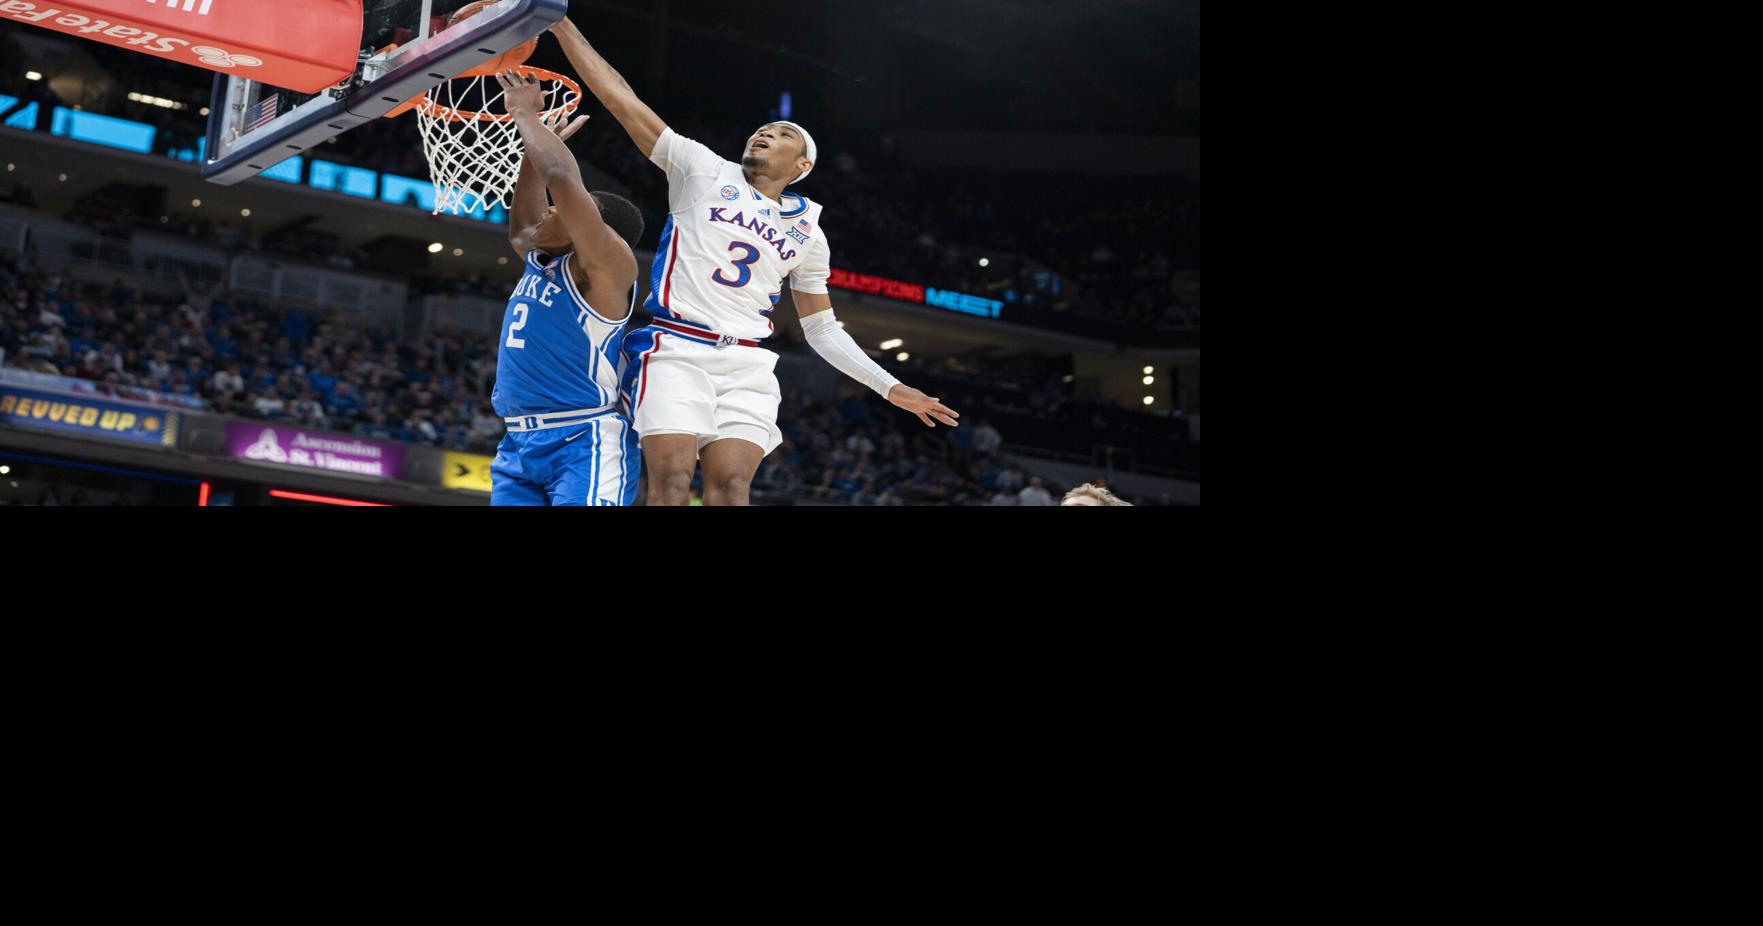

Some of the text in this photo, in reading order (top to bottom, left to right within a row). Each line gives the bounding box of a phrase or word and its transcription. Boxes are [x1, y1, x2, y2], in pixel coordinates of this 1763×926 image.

[708, 207, 797, 261] KANSAS
[711, 240, 761, 288] 3
[827, 267, 1004, 318] HAMPIONS MEET
[505, 302, 529, 349] 2
[1, 395, 137, 432] REVVED UP
